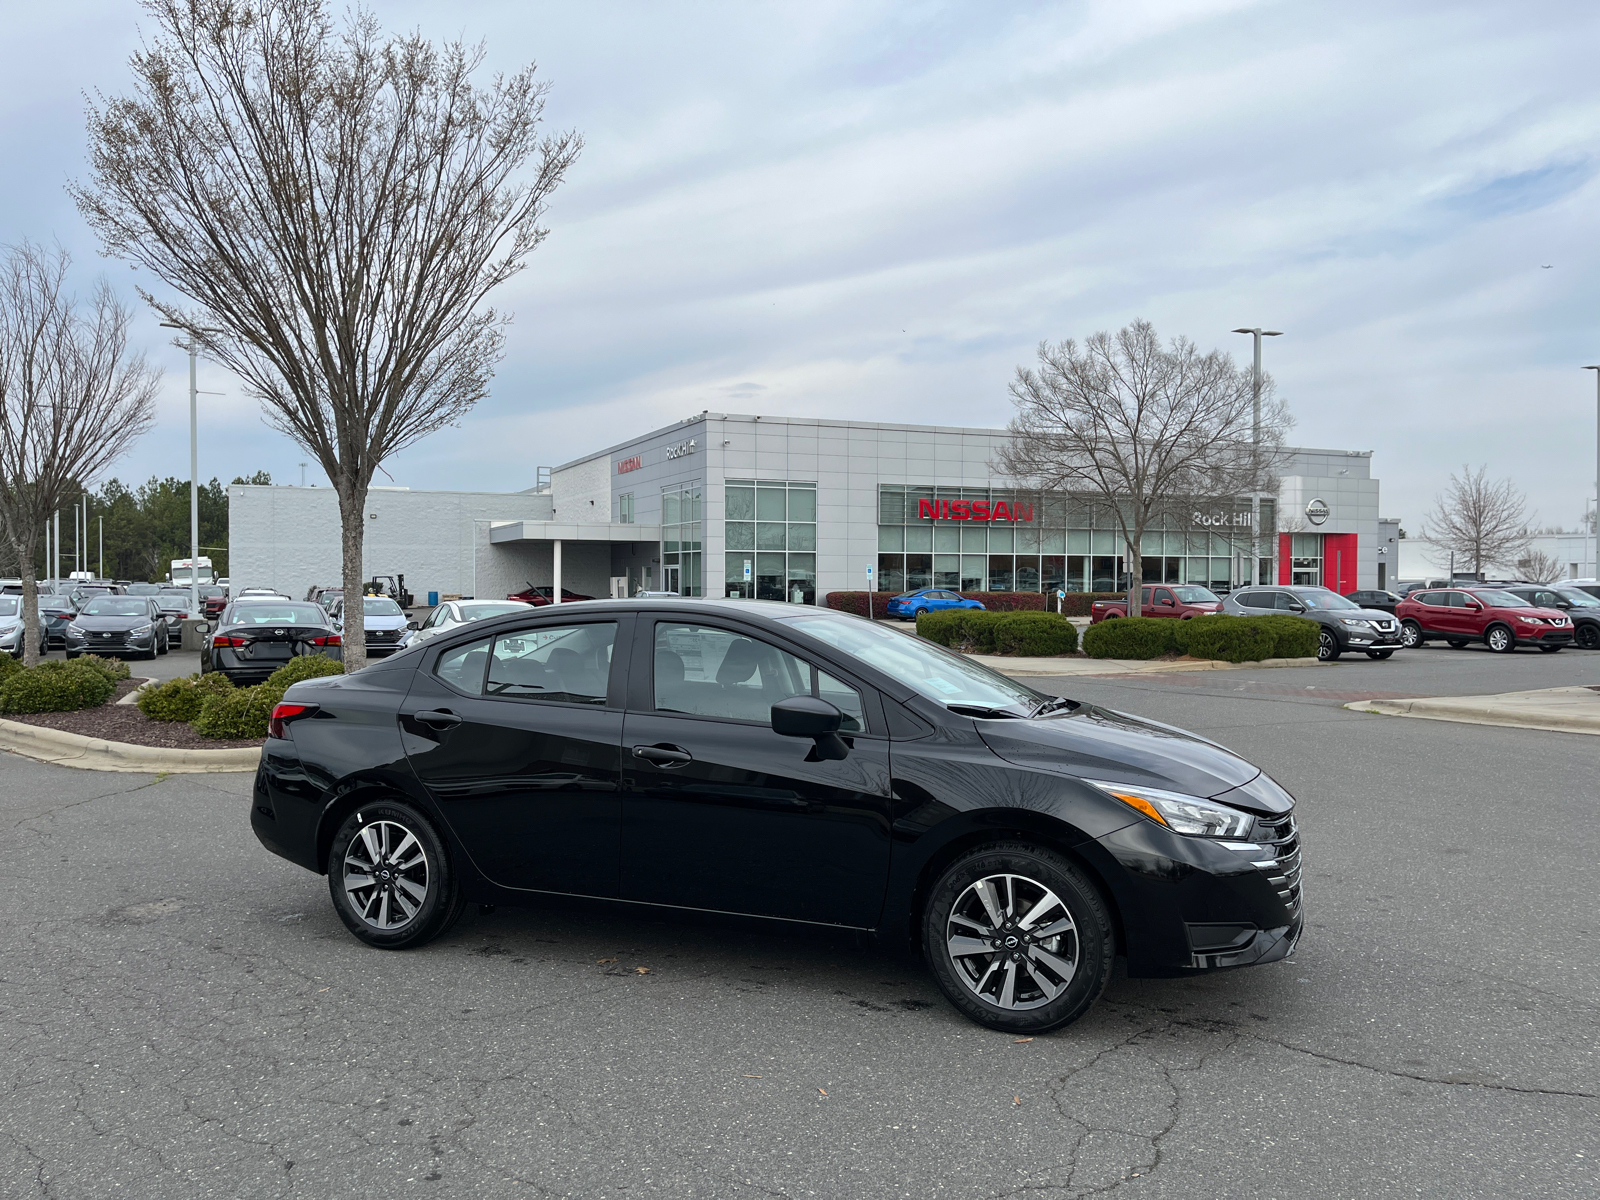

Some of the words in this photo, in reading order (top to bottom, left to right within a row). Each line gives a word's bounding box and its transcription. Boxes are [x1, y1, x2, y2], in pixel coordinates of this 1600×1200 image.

[617, 456, 641, 474] NISSAN
[918, 498, 1034, 521] NISSAN
[1191, 511, 1229, 526] Rock
[1232, 511, 1251, 527] Hil
[377, 808, 412, 825] KUMHO
